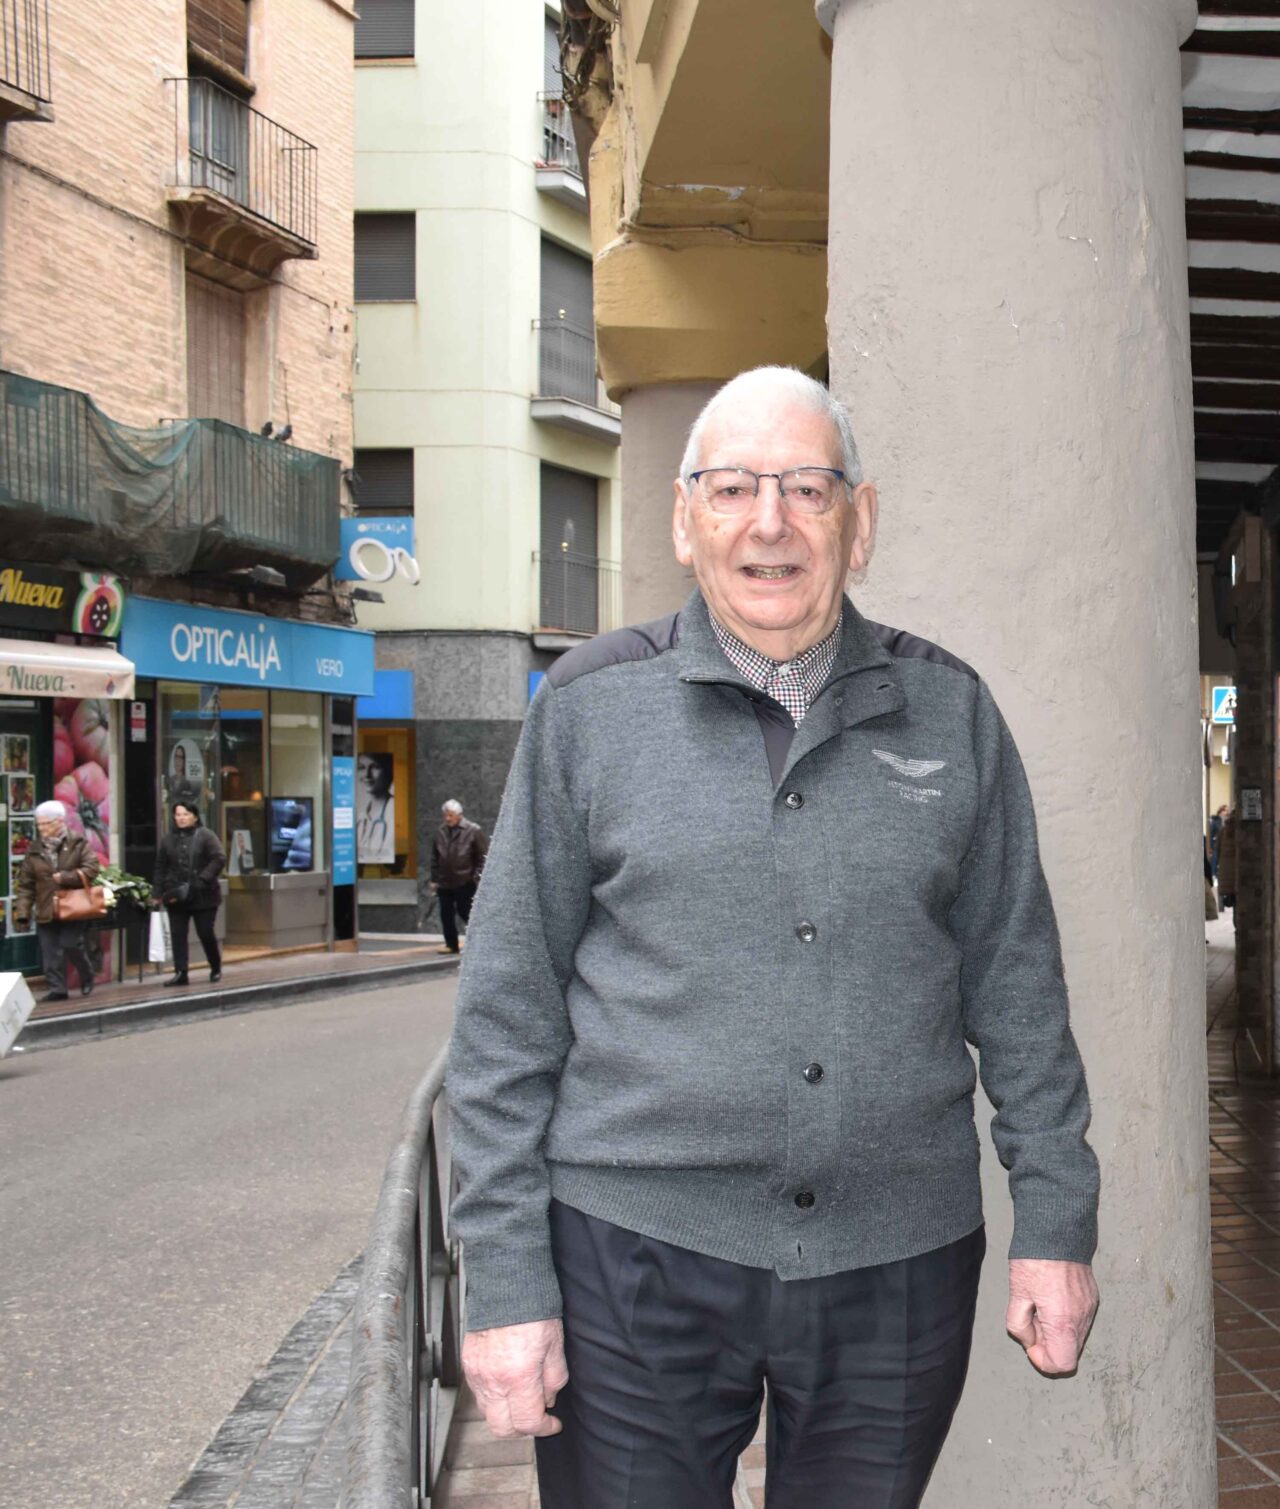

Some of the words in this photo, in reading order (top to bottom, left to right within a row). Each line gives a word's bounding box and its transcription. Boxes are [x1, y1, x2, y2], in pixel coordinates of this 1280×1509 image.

[0, 568, 63, 609] Nueva
[7, 665, 64, 692] Nueva
[316, 657, 344, 677] VERO
